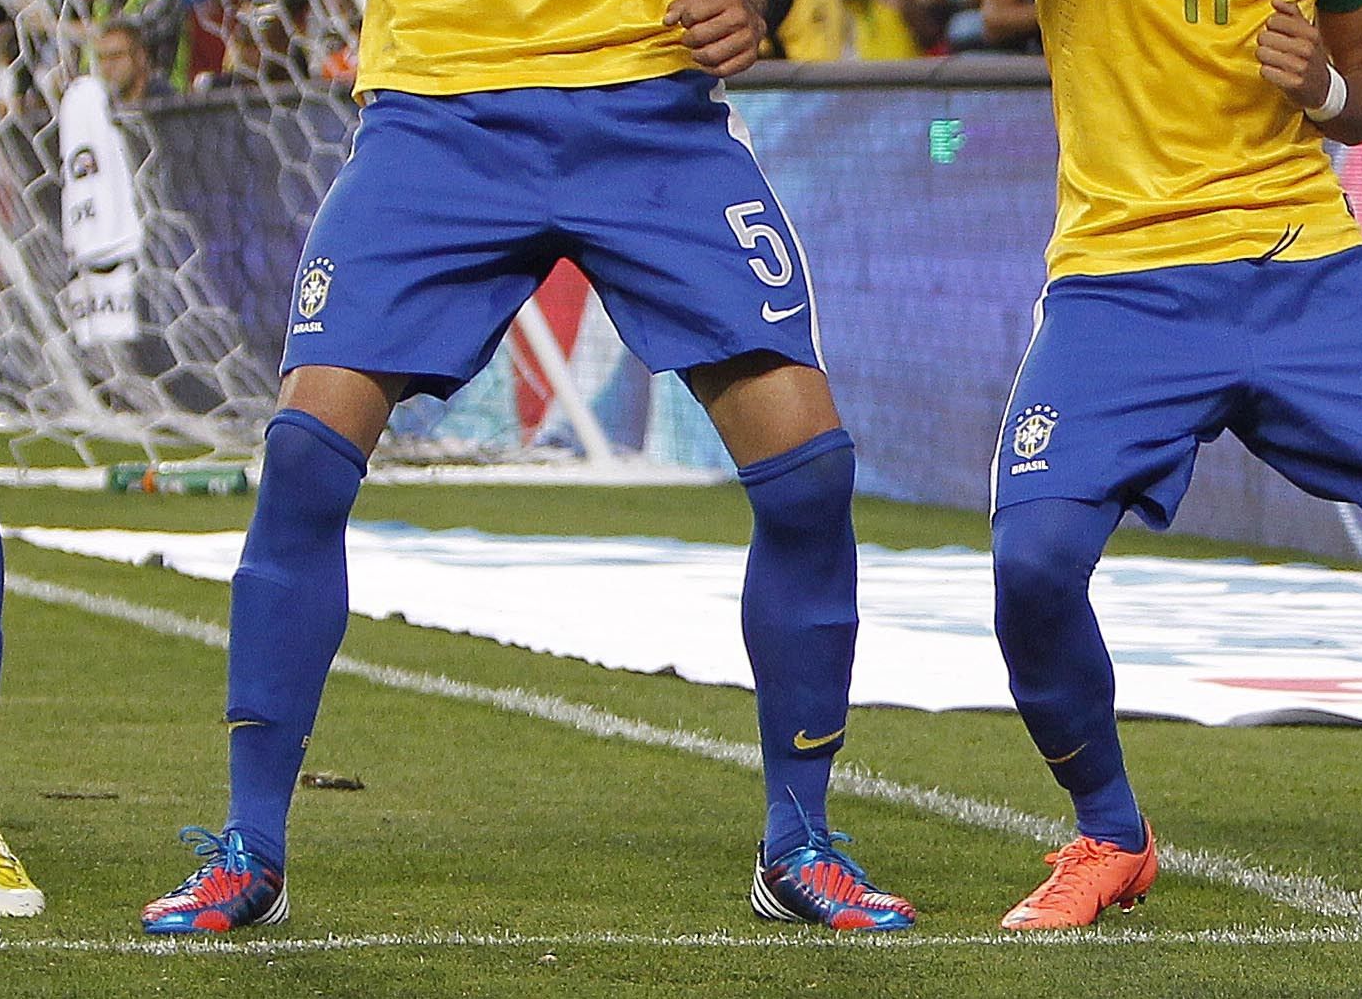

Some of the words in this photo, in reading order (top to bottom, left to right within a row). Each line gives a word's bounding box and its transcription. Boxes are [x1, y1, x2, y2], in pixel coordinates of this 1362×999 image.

[724, 200, 792, 287] 5
[292, 322, 324, 335] BRASIL
[1011, 460, 1049, 475] BRASIL
